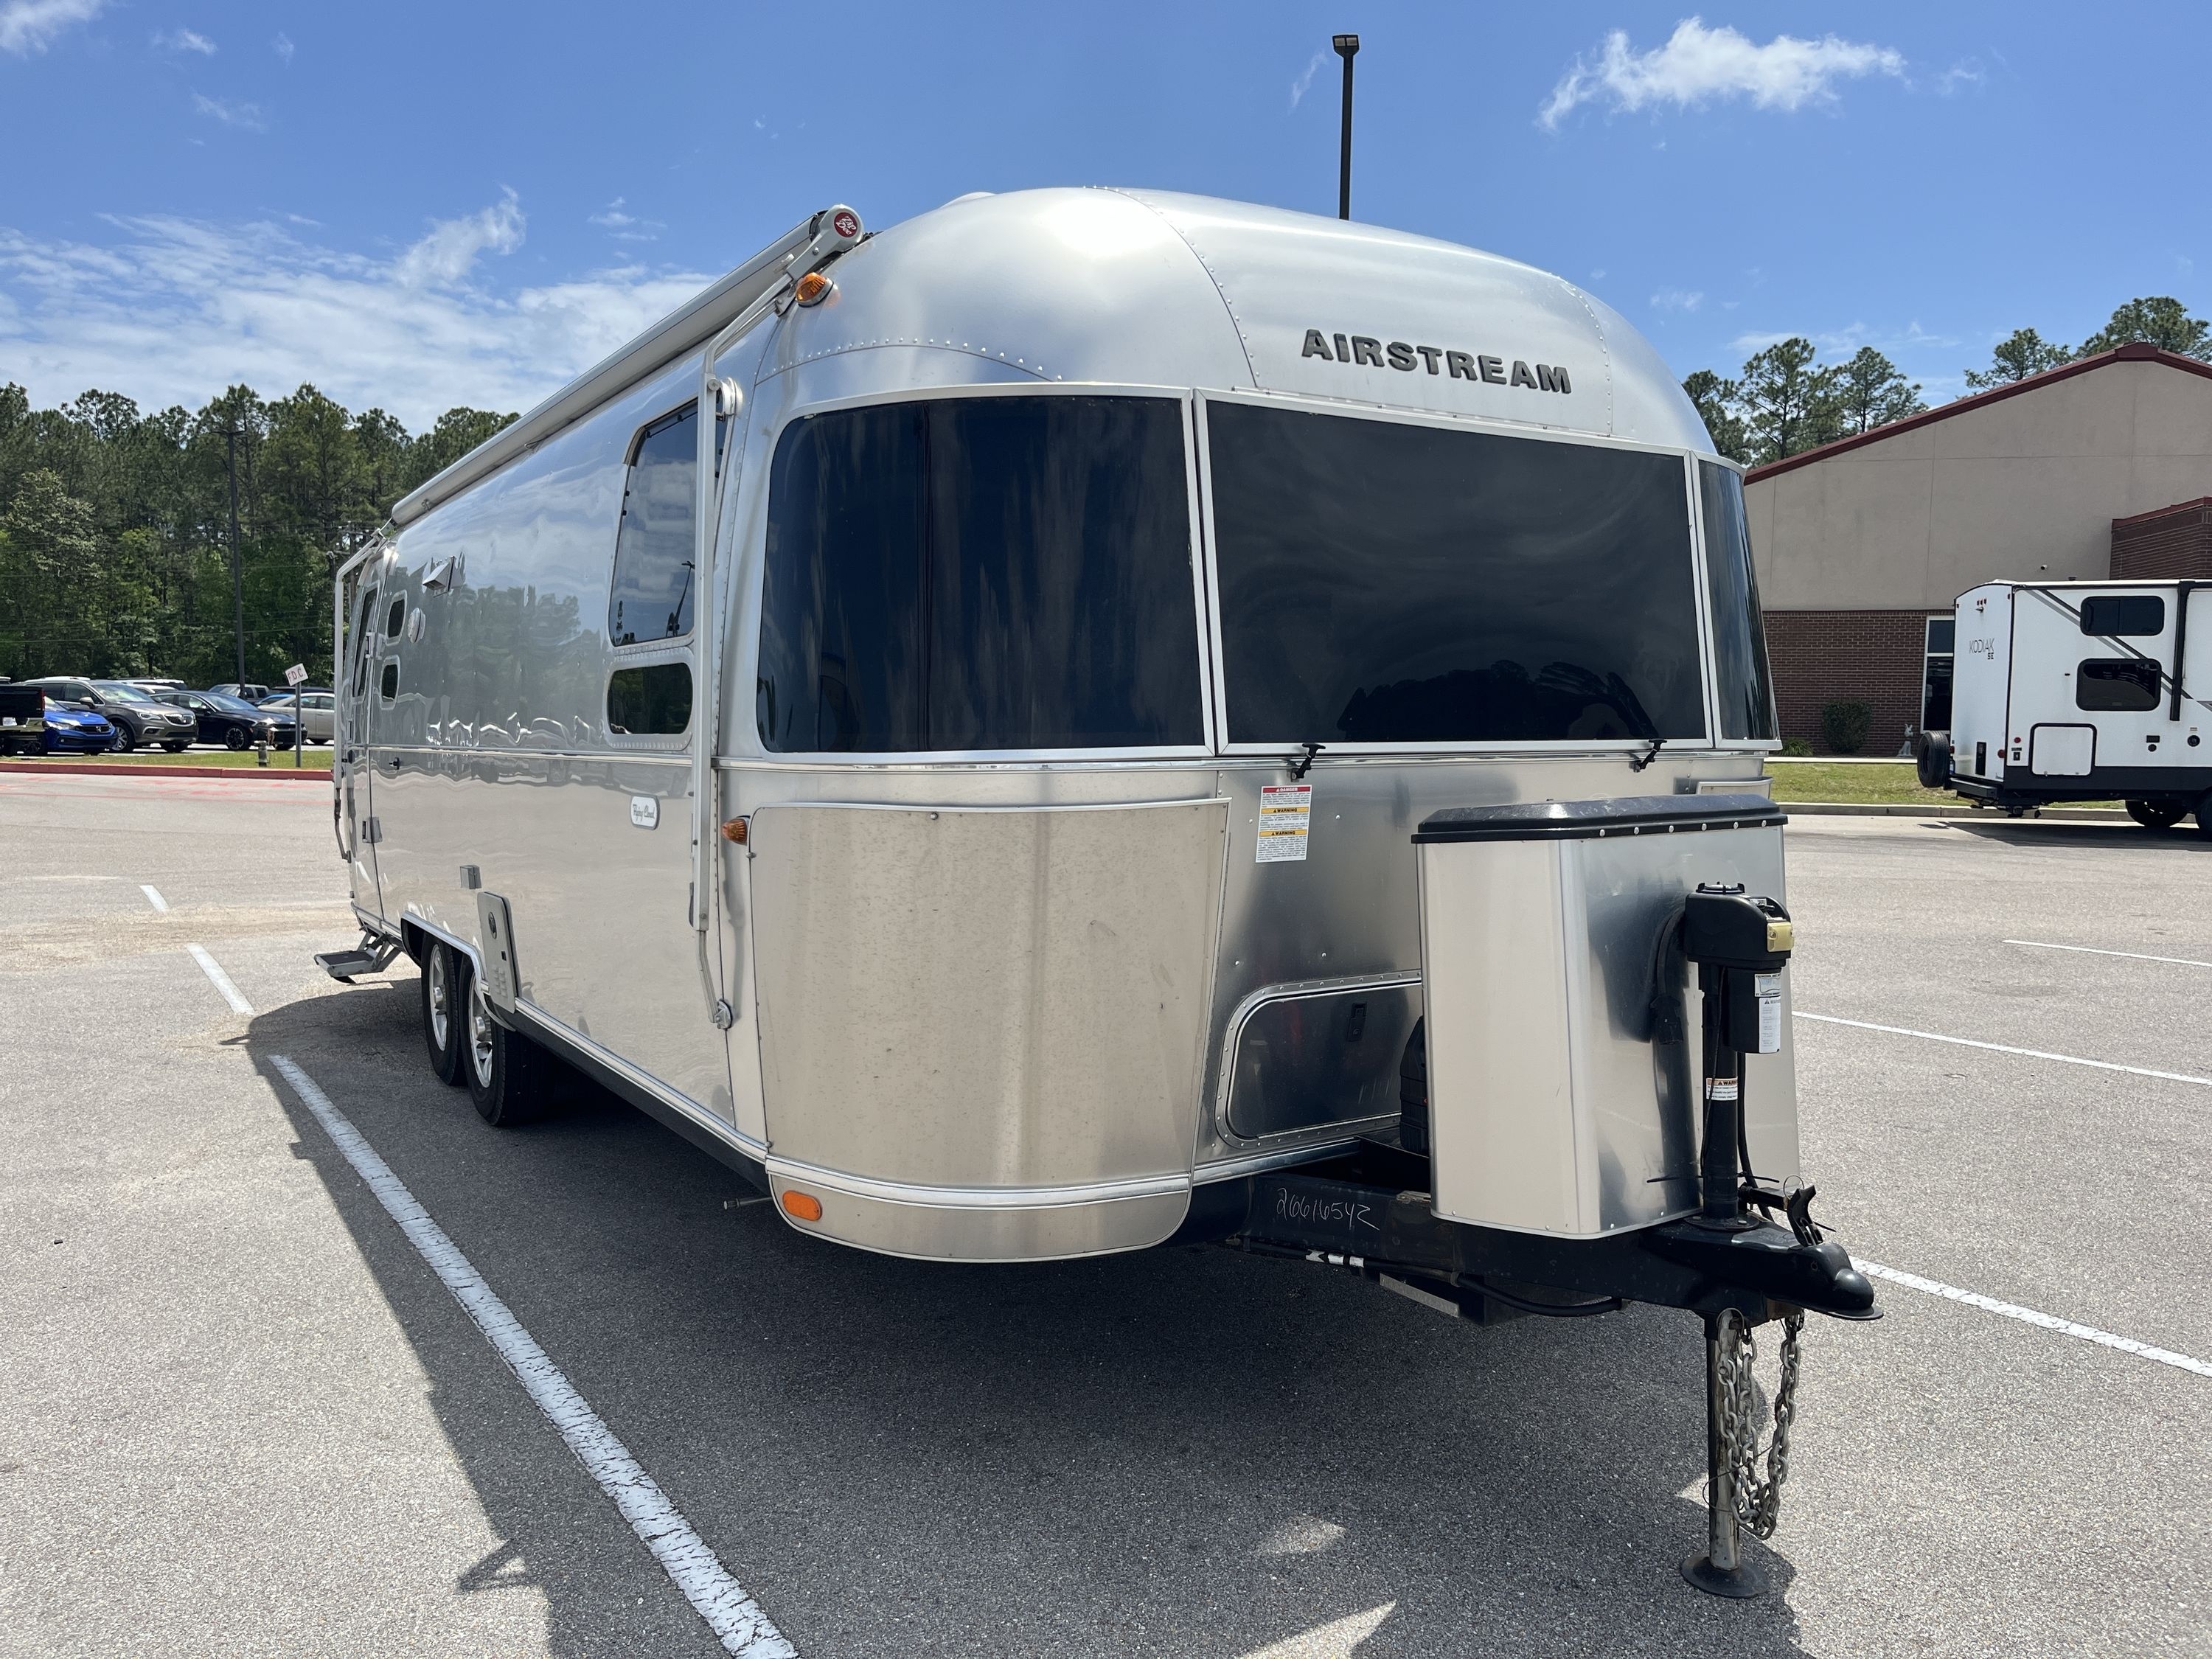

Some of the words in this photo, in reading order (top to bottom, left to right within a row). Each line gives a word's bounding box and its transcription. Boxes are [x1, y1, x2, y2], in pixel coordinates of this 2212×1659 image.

[1301, 329, 1572, 394] AIRSTREAM
[1969, 638, 1994, 654] KODIAK
[1987, 652, 1994, 660] SE
